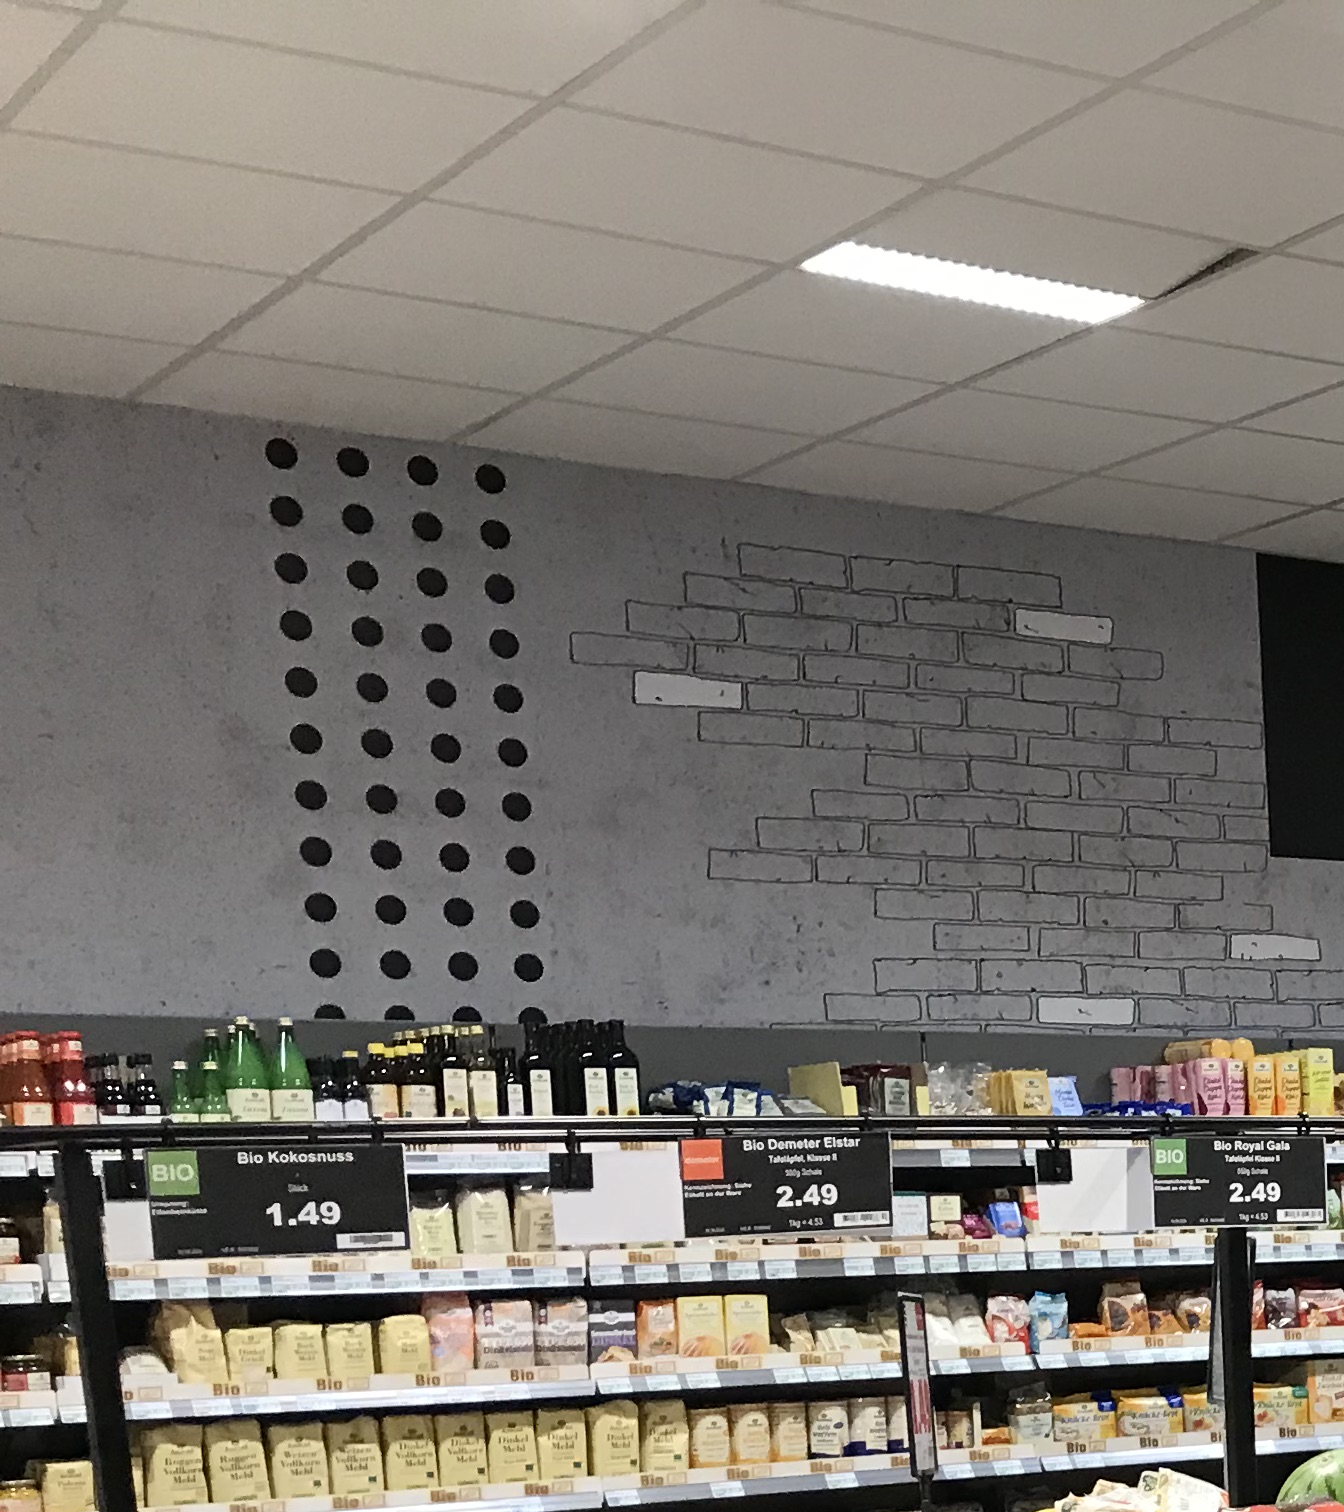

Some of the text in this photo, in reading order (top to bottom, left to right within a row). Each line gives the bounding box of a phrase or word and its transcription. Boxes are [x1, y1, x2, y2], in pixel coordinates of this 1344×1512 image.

[743, 1137, 860, 1151] Bio Demeter Elstar
[1214, 1141, 1290, 1153] Bio Royal Gala
[237, 1151, 354, 1165] Bio Kokosnuss
[1155, 1150, 1184, 1164] BIO
[151, 1164, 194, 1182] BIO
[776, 1184, 838, 1208] 2.49
[1229, 1182, 1281, 1203] 2.49
[266, 1202, 341, 1226] 1.49
[808, 1218, 823, 1226] 4.53
[1060, 1240, 1080, 1249] Bio
[629, 1252, 651, 1263] Bio
[208, 1263, 237, 1274] Bio
[412, 1258, 437, 1269] Bio
[1072, 1340, 1092, 1351] Bio
[510, 1370, 534, 1381] Bio
[213, 1384, 240, 1395] Bio
[498, 1435, 529, 1444] Dinkel
[548, 1432, 579, 1442] Dinkel
[1140, 1437, 1159, 1448] Bio
